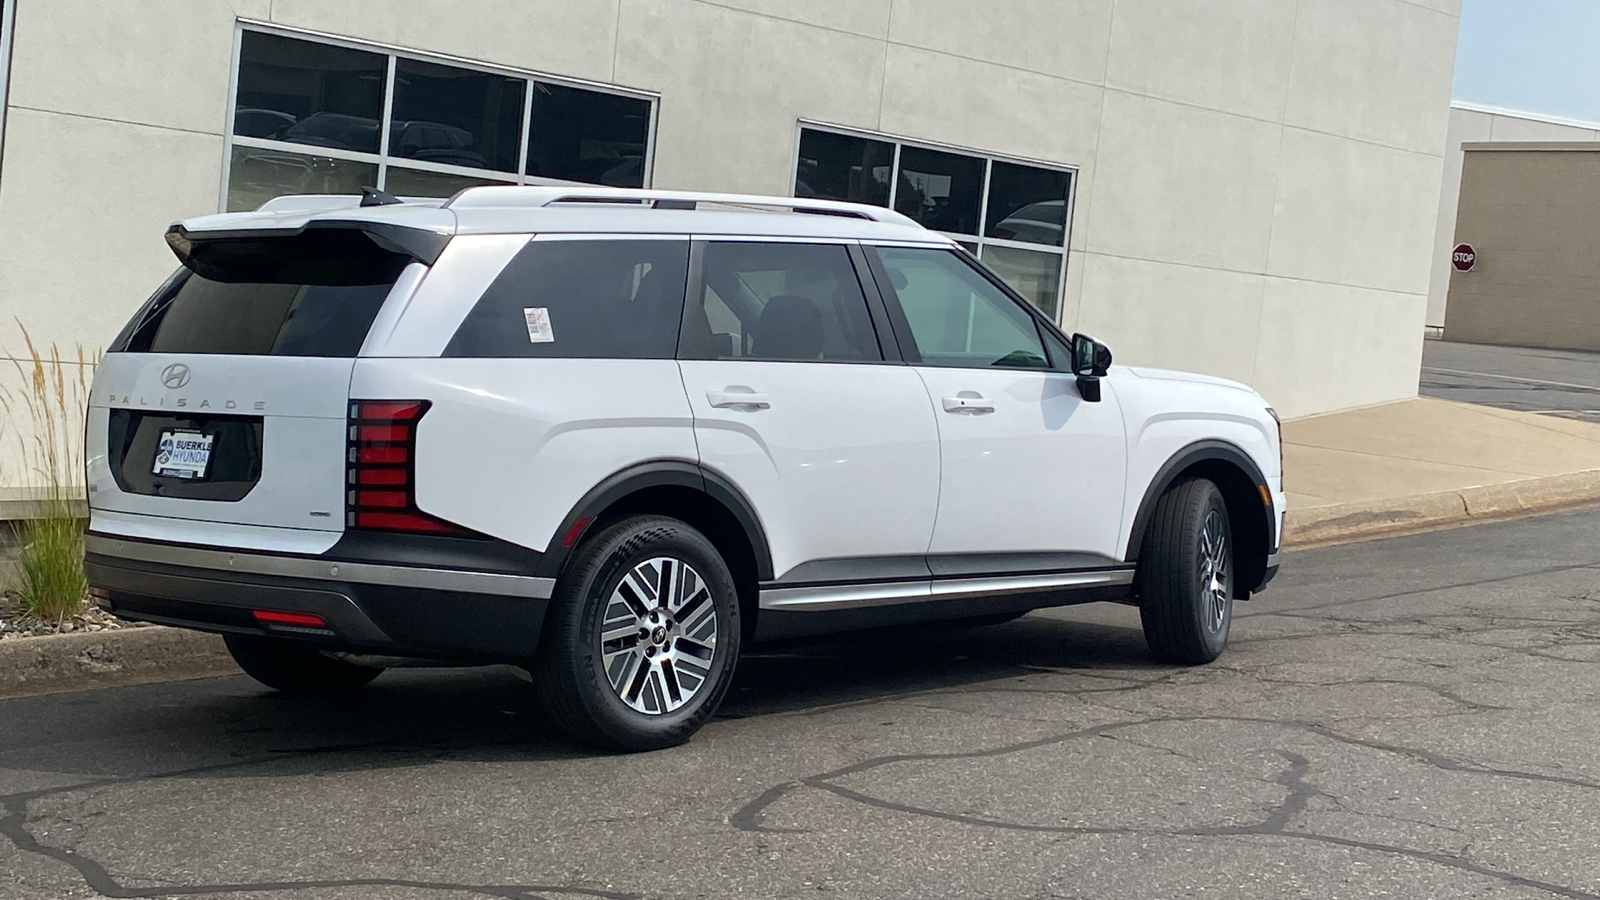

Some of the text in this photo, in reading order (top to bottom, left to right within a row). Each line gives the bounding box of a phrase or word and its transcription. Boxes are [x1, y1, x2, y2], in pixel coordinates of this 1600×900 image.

[1453, 252, 1474, 263] STOP
[109, 395, 266, 410] PALISADE
[176, 440, 212, 451] BUERKLE
[173, 450, 207, 463] HYUNDA
